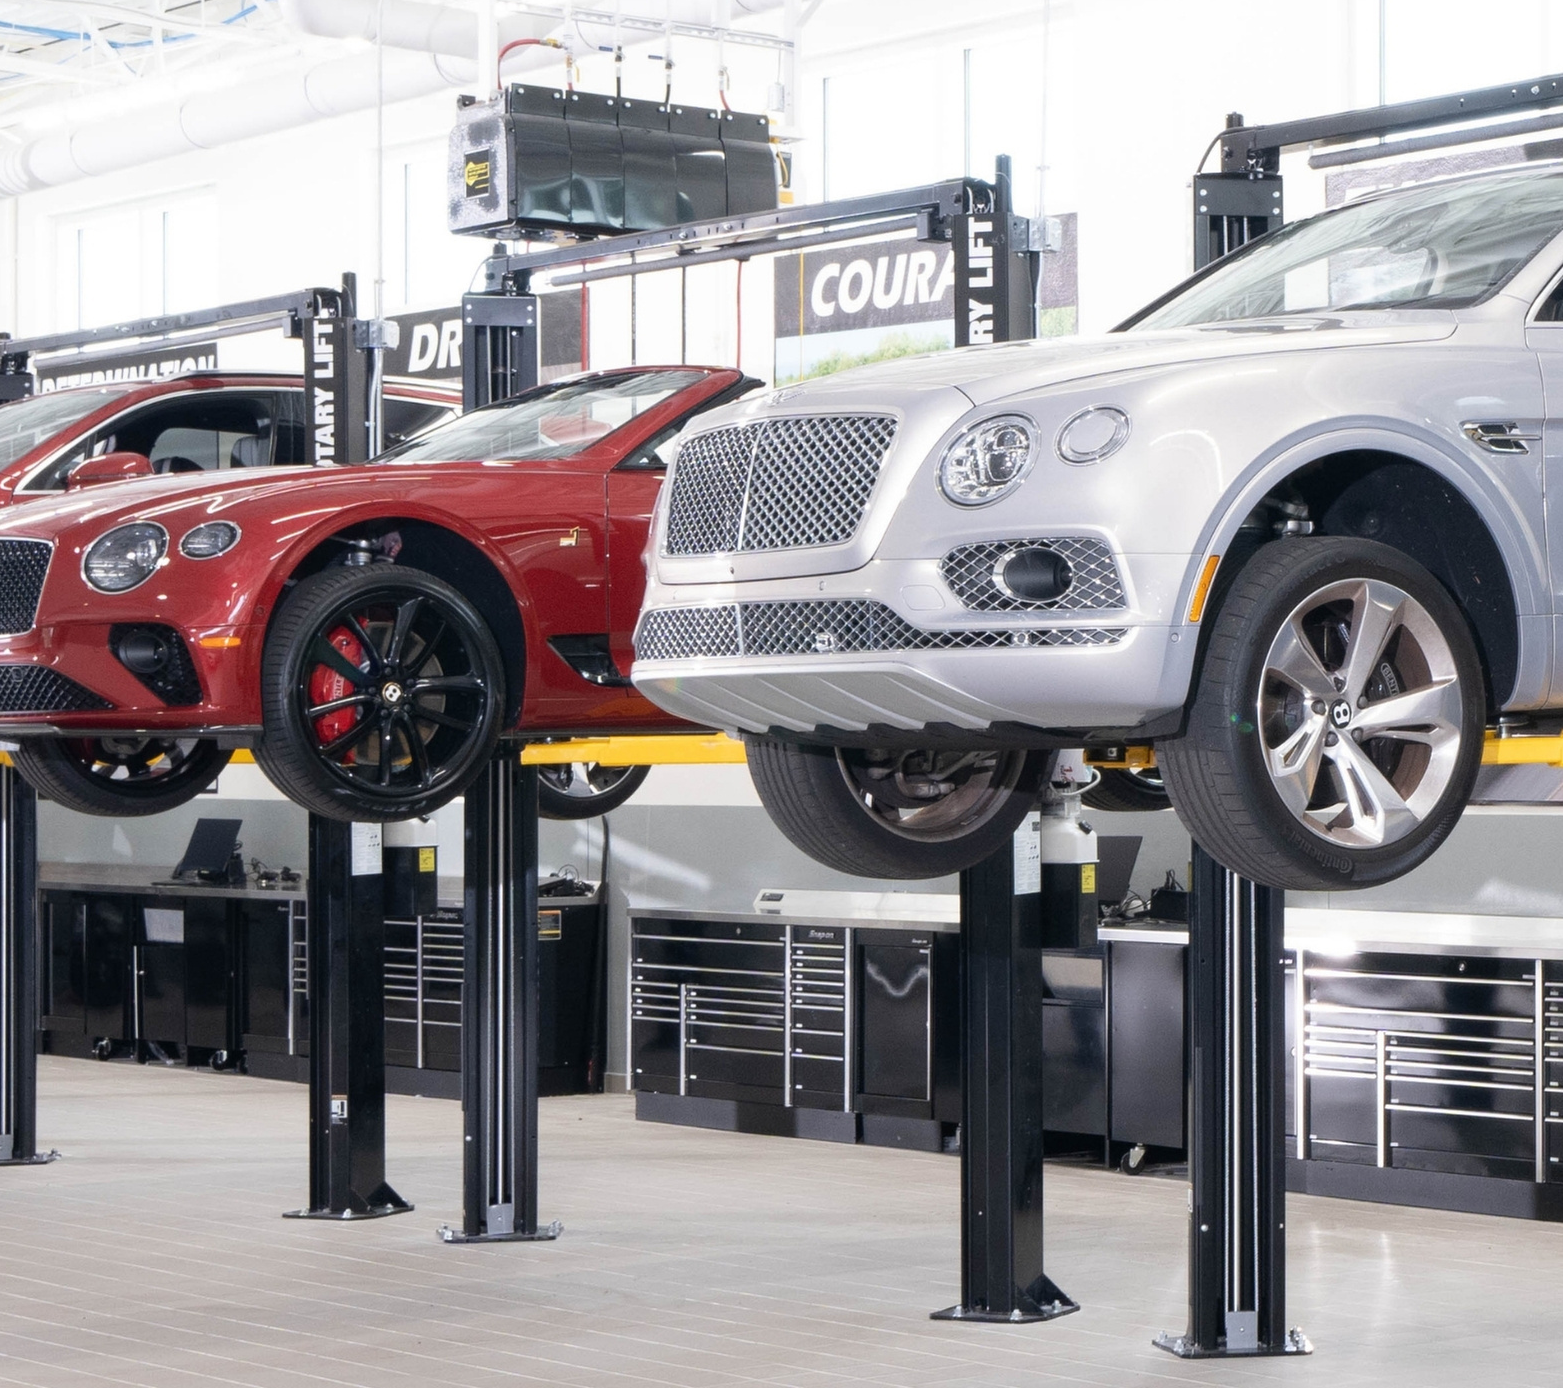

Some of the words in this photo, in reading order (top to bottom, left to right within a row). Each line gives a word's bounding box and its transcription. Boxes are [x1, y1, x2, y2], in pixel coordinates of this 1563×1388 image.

[811, 249, 955, 317] COURA
[968, 216, 993, 288] LIFT
[313, 320, 334, 378] LIFT
[408, 319, 463, 372] DR
